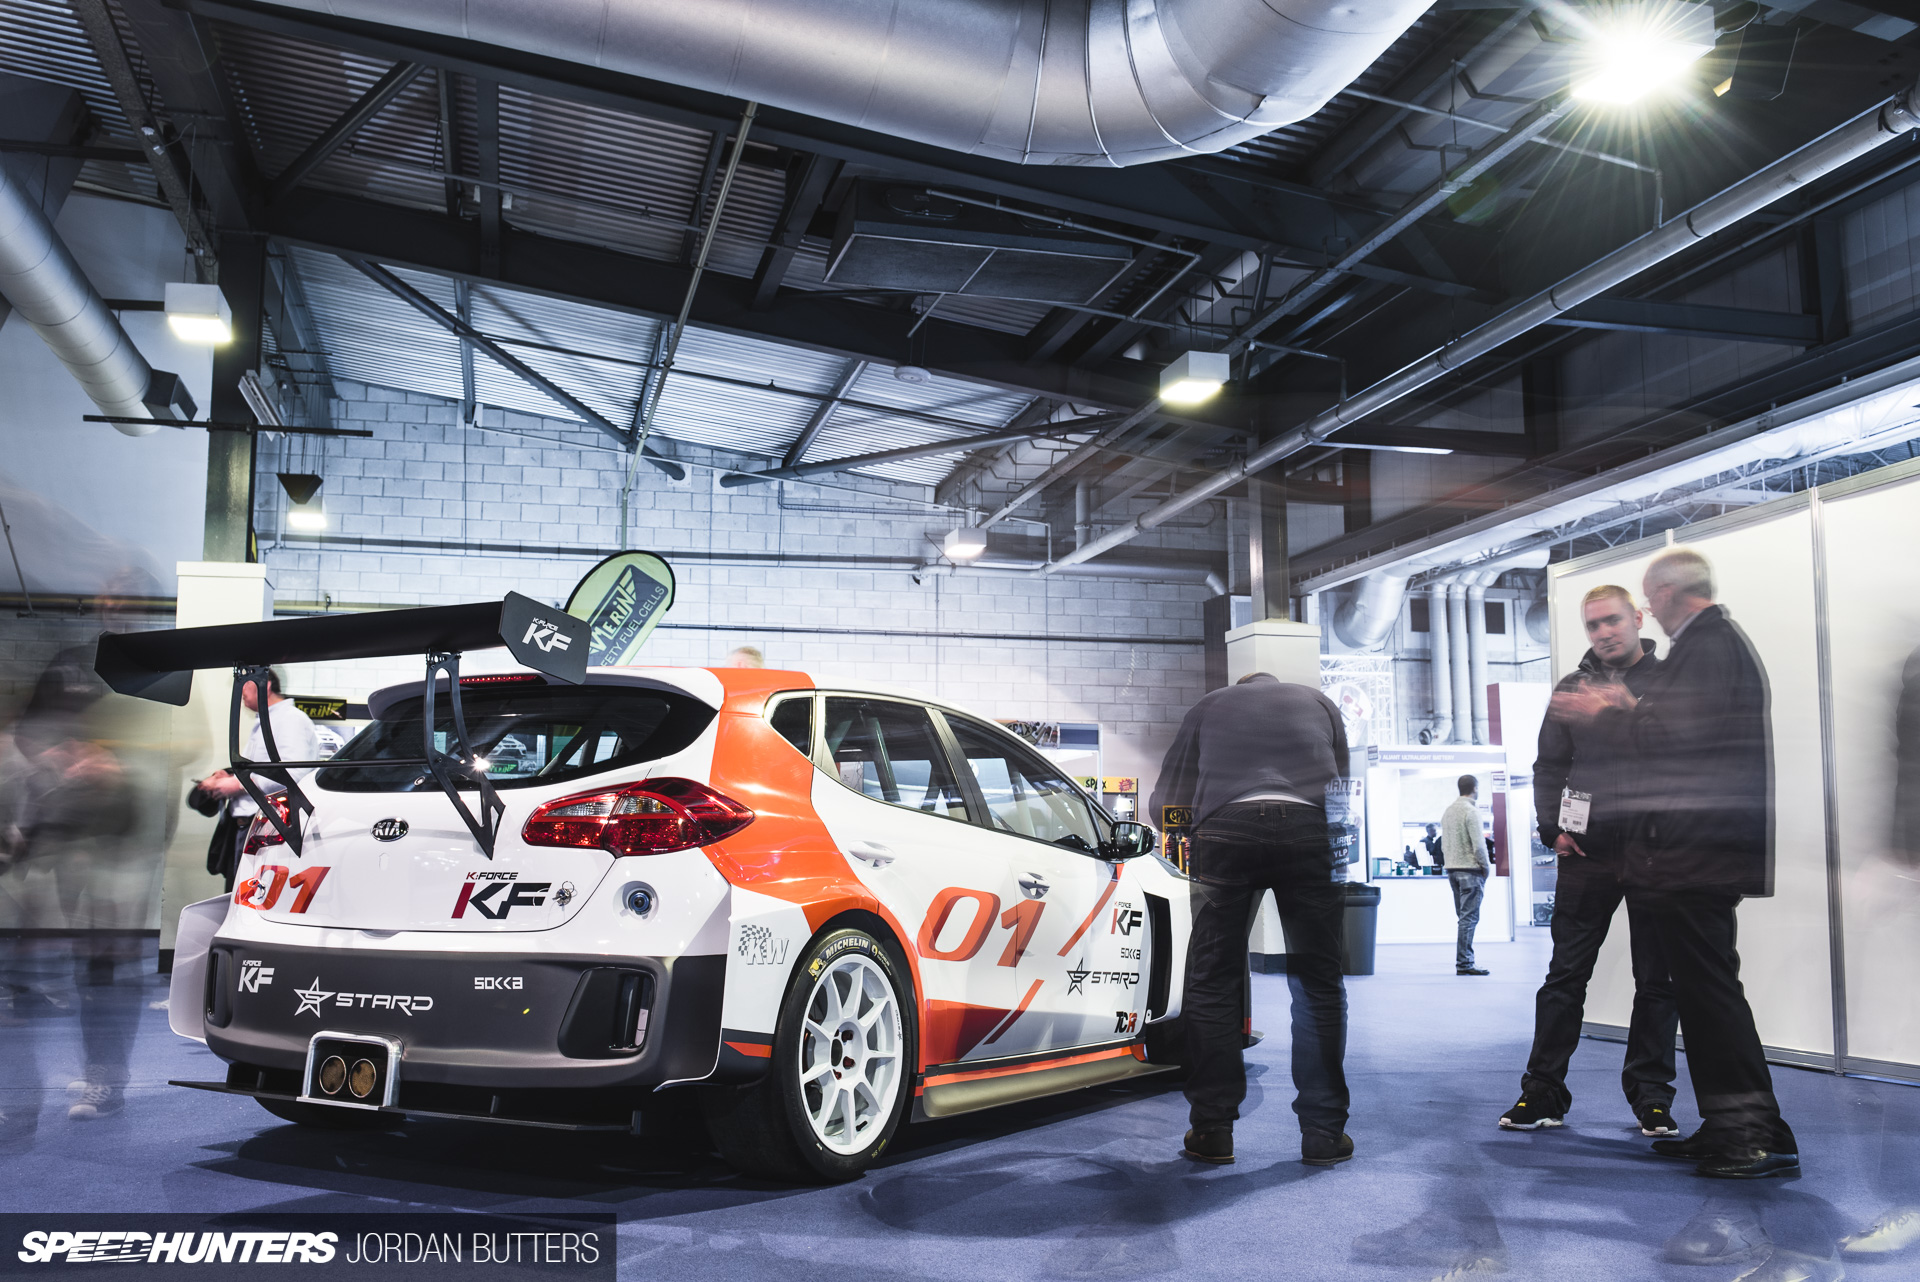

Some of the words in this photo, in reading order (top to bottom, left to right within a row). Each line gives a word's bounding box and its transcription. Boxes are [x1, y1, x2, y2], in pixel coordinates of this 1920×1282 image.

[522, 622, 572, 653] KF
[600, 641, 623, 666] FETY
[619, 617, 643, 644] FUEL
[638, 585, 666, 617] CELLS
[374, 821, 403, 836] KIA
[1333, 848, 1348, 858] YLP
[234, 864, 332, 914] 01
[450, 882, 552, 920] KF
[917, 886, 1046, 968] 01
[1111, 908, 1143, 936] KF
[745, 937, 790, 965] KW
[825, 937, 869, 959] MICHELIN
[238, 966, 275, 993] KF
[1091, 971, 1140, 990] STARD
[335, 992, 434, 1017] STARD
[1114, 1011, 1138, 1034] TCR
